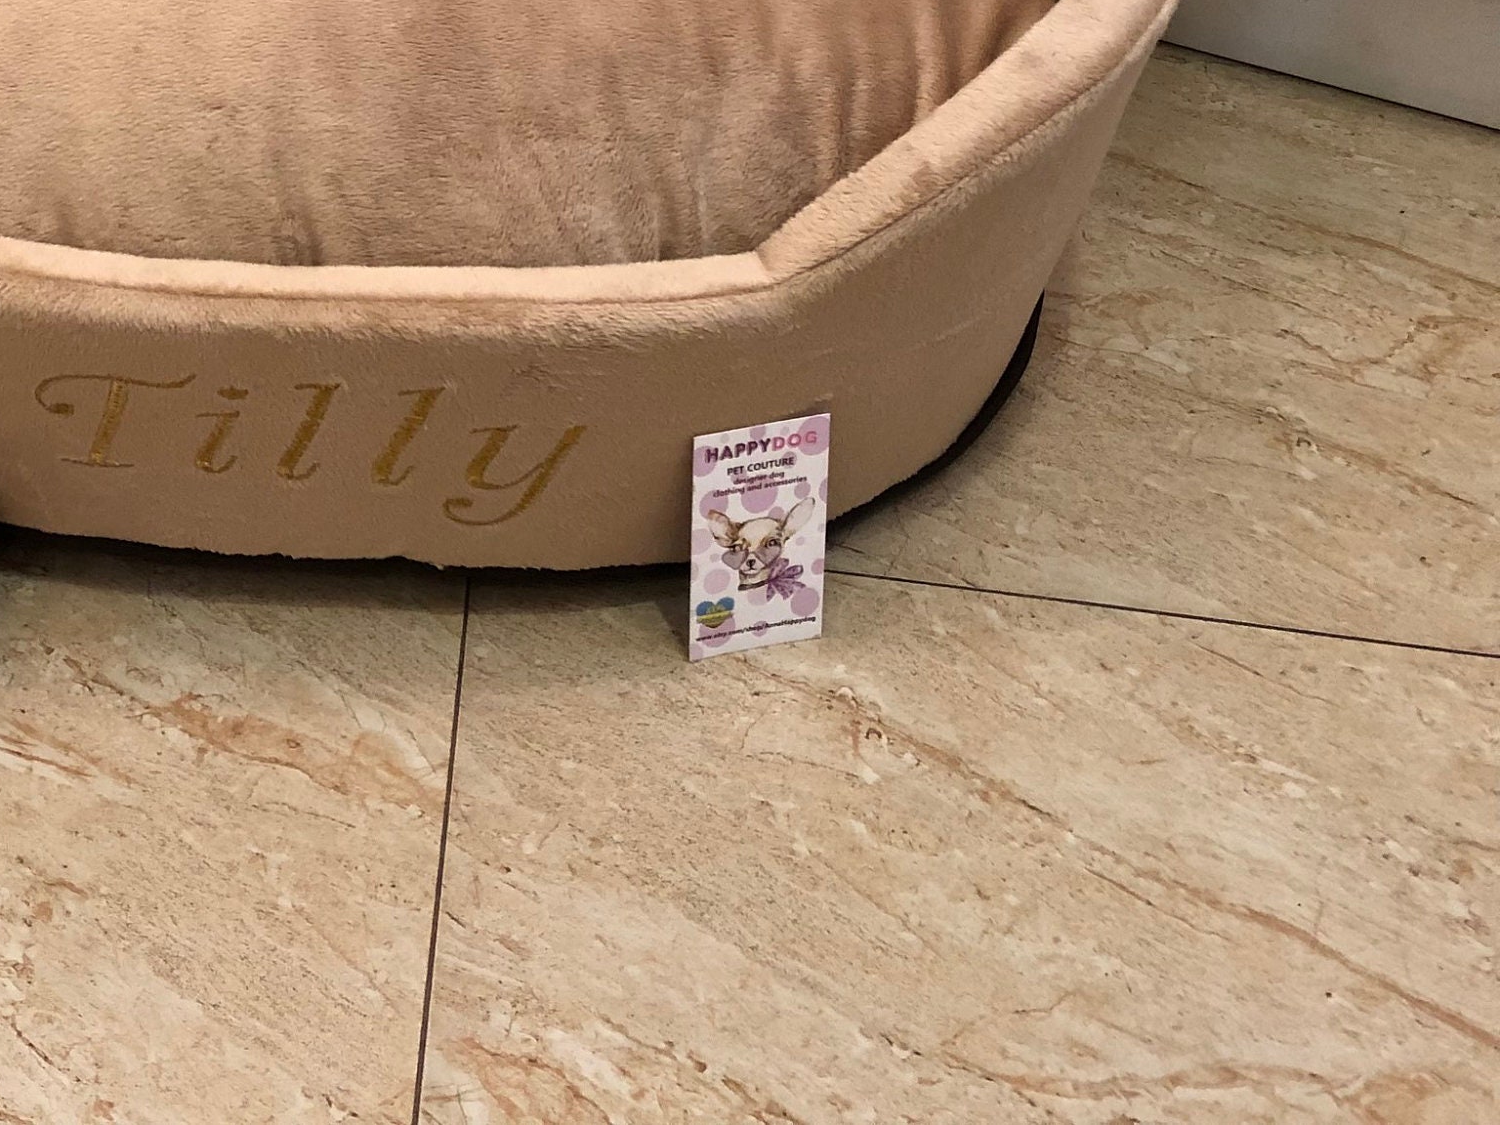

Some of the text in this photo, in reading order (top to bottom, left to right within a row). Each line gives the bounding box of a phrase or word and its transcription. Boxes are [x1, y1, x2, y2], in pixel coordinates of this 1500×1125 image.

[34, 374, 587, 527] Tilly
[727, 456, 795, 476] PET COUTURE
[769, 471, 785, 480] dog
[713, 475, 807, 498] clothing and accessories
